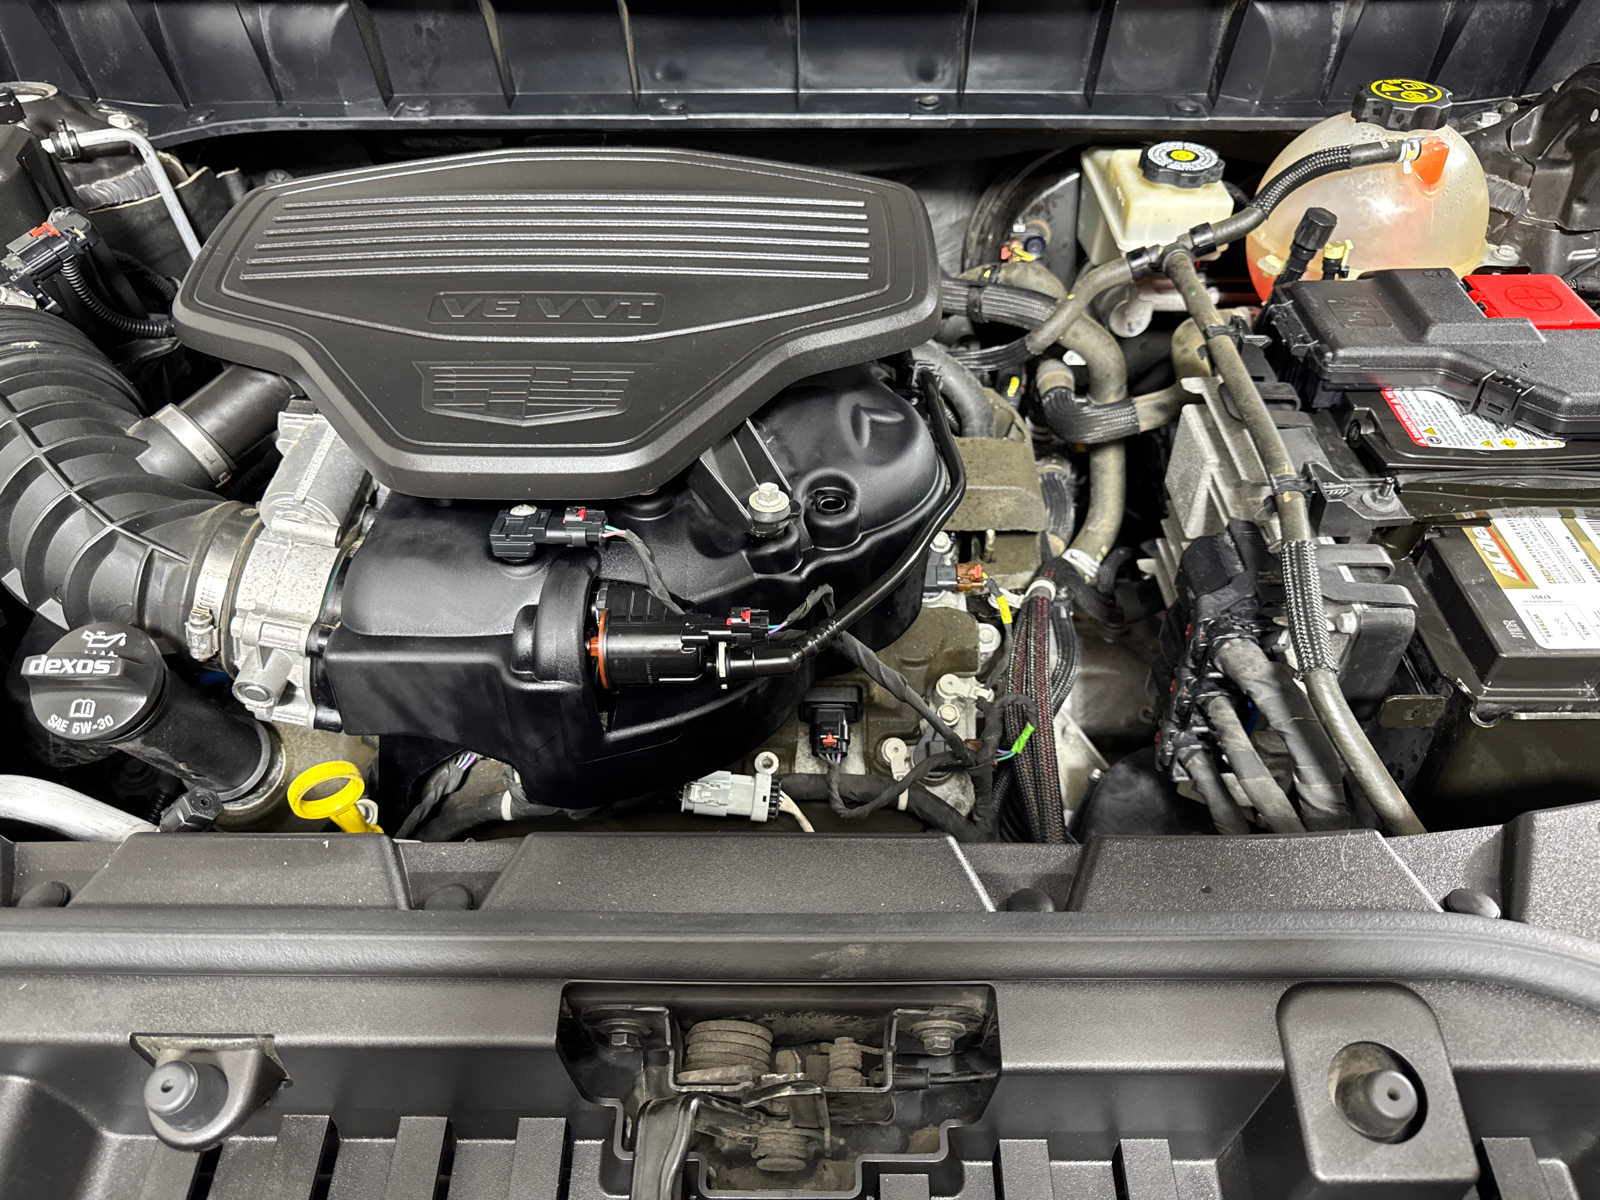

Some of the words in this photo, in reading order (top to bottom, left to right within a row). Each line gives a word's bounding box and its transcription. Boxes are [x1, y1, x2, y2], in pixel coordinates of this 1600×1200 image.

[442, 299, 521, 317] V6
[536, 299, 655, 318] VVT
[1472, 527, 1520, 580] ACDe
[1514, 532, 1545, 568] MAINTENANCE
[28, 654, 110, 674] dexos
[47, 714, 69, 733] SAE
[72, 716, 114, 735] 5W-30
